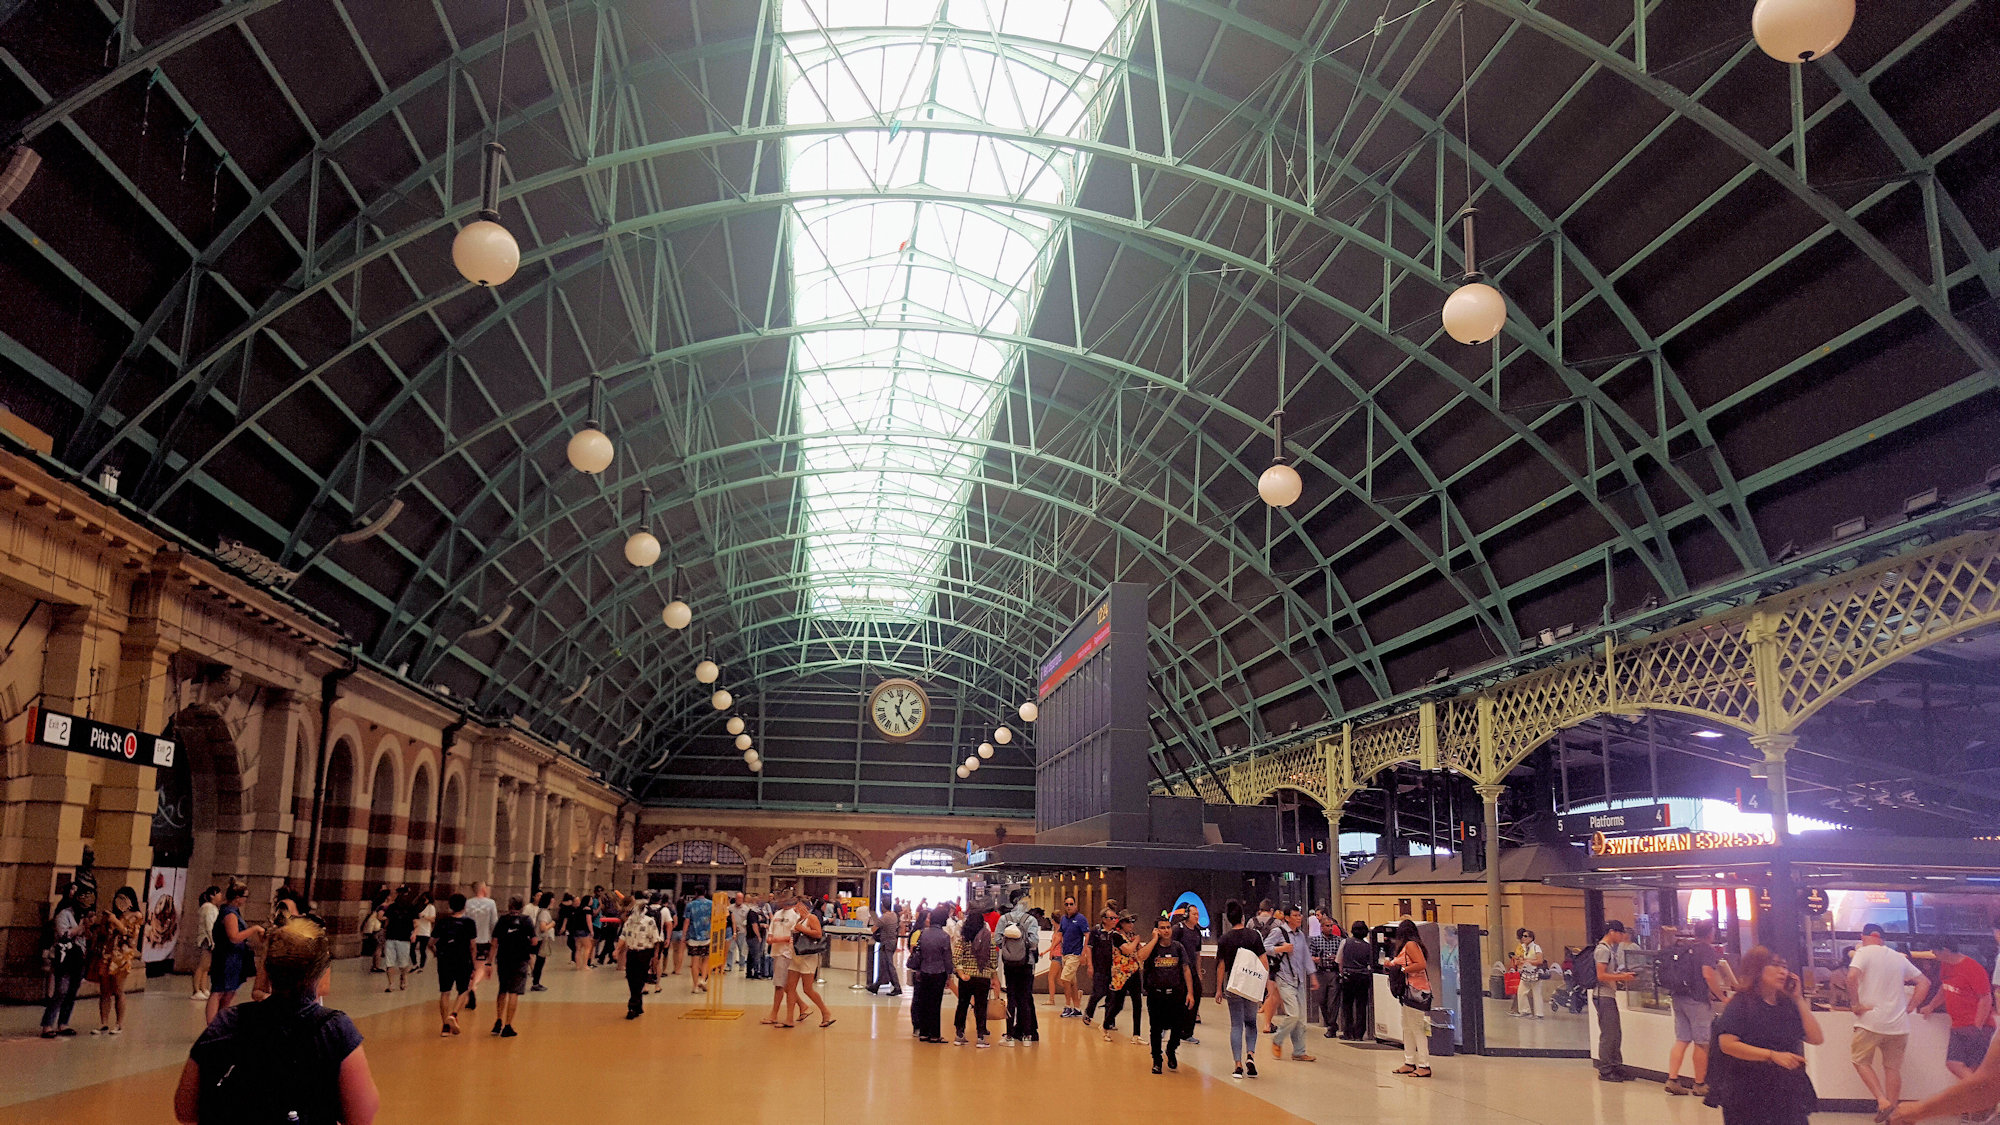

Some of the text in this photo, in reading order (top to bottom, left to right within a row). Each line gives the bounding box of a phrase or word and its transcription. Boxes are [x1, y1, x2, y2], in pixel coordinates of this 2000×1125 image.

[60, 721, 68, 741] 2
[90, 727, 109, 750] Pitt
[110, 732, 122, 753] St
[165, 746, 172, 762] 2
[1748, 794, 1758, 809] 4
[1557, 810, 1662, 832] 5 Platforms 4
[1468, 825, 1477, 837] 5
[1316, 841, 1323, 850] 6
[1607, 827, 1777, 855] SWITCHMAN ESPRESSO
[798, 866, 835, 874] NewsLink
[1242, 967, 1263, 980] HYPE
